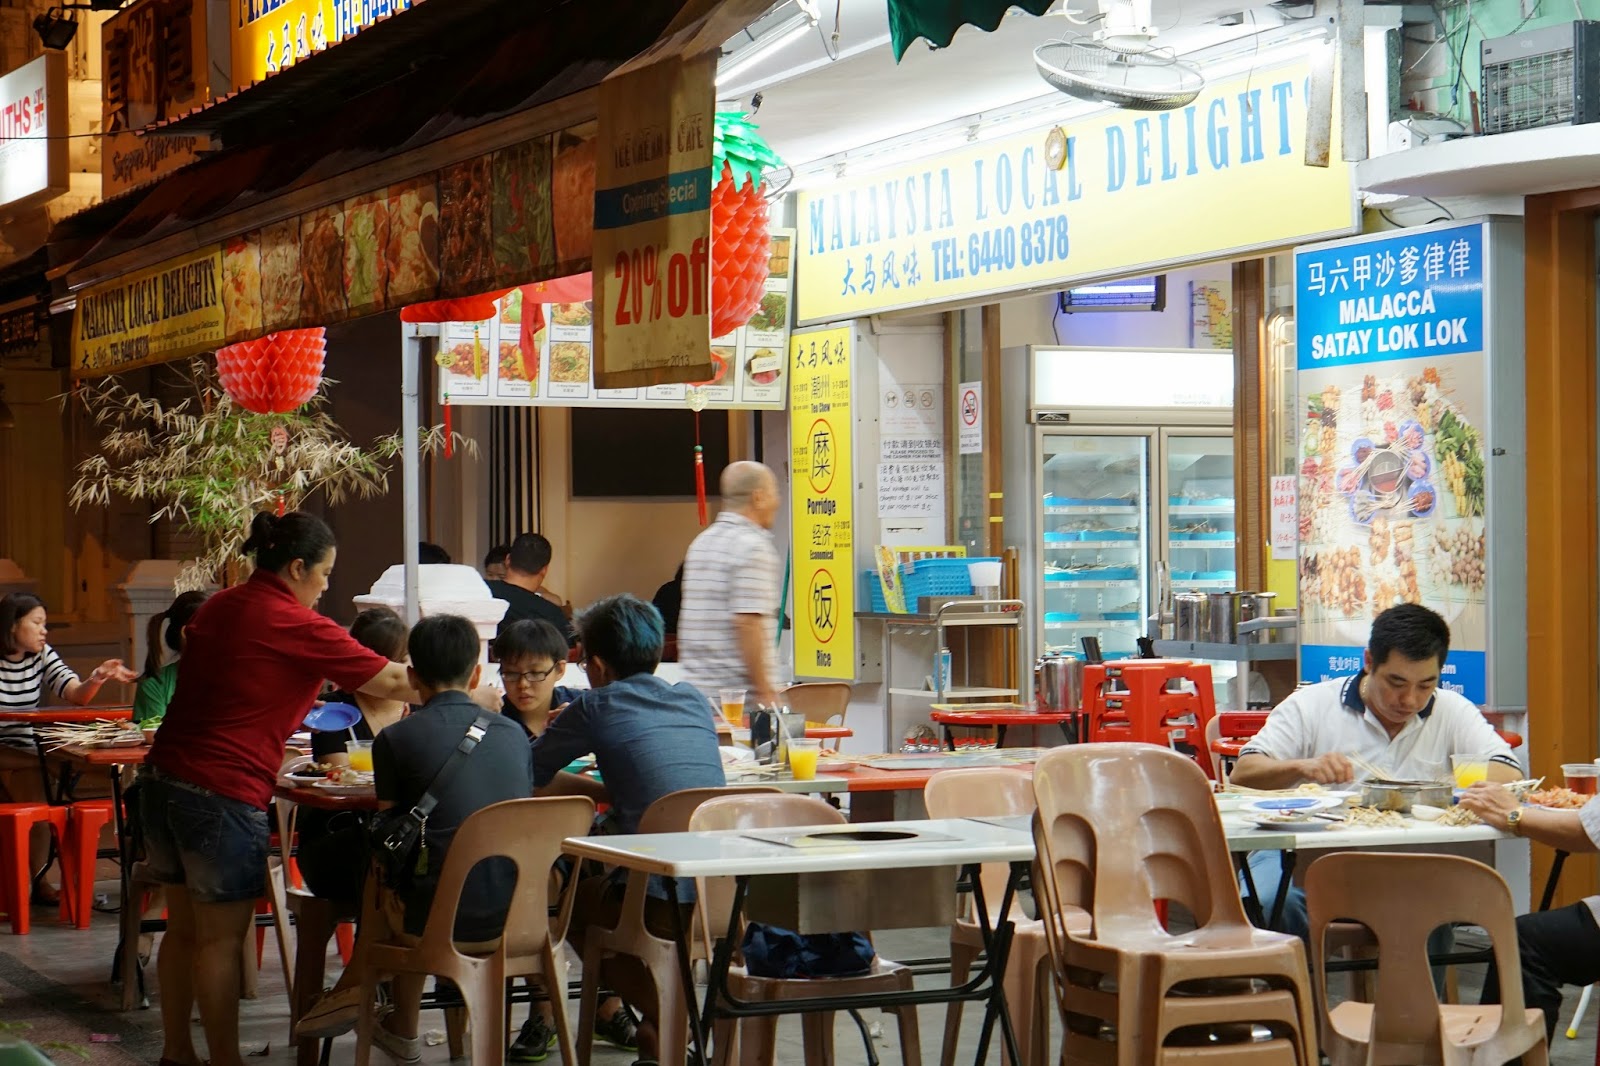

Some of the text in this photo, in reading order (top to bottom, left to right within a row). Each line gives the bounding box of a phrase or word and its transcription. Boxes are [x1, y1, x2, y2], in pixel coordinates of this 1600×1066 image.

[809, 75, 1311, 256] MALAYSIA LOCAL DELIGHT
[659, 176, 698, 206] Secial
[841, 243, 922, 297] 大马风味
[932, 214, 1070, 283] TEL: 6440 8378
[1307, 237, 1472, 297] 马六甲沙爹律律
[80, 286, 128, 342] MALAYSIA
[127, 275, 161, 330] LOCAL
[161, 255, 218, 320] DELIGHTS
[614, 244, 662, 326] 20%
[1339, 288, 1437, 326] MALACCA
[795, 337, 847, 370] 大马风味
[1311, 316, 1469, 361] SATAY LOK LOK
[807, 498, 836, 516] Porridge
[812, 523, 832, 547] 经济
[813, 582, 833, 630] 饭
[816, 649, 832, 668] Rice
[1328, 656, 1360, 672] 营业时间
